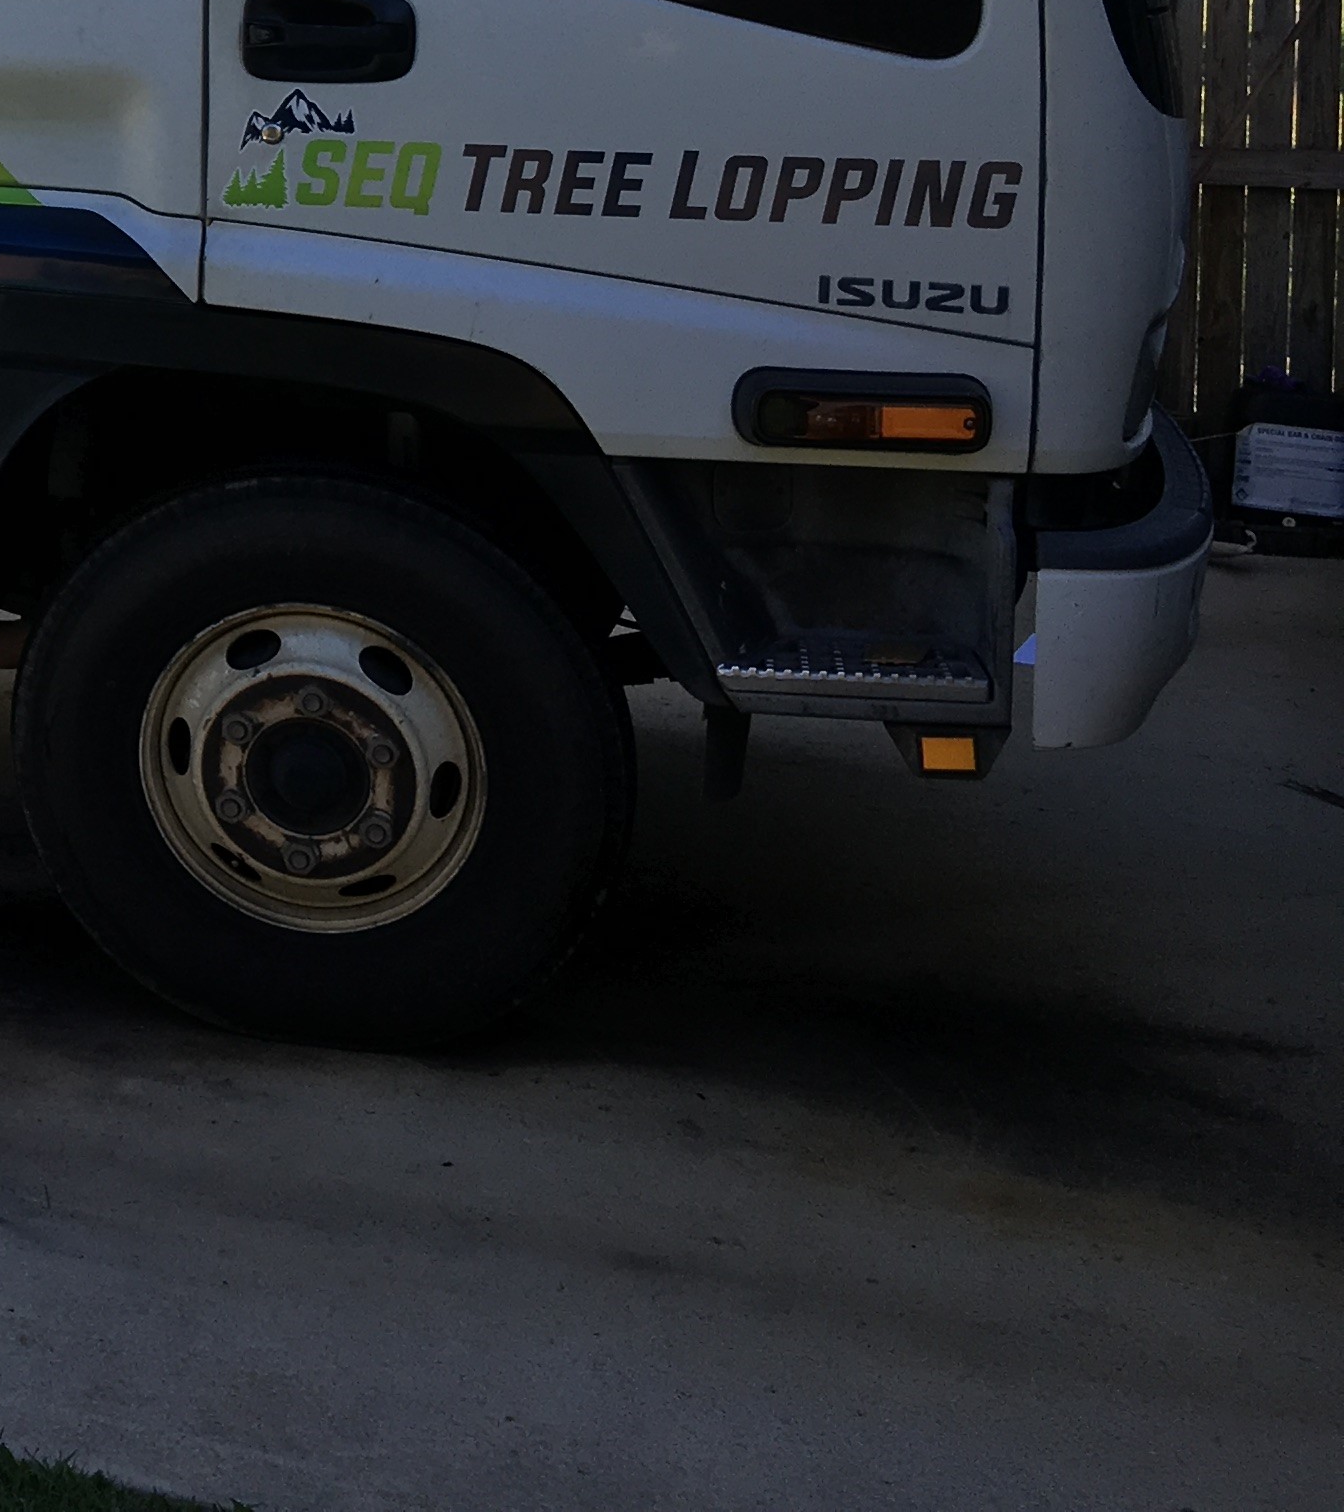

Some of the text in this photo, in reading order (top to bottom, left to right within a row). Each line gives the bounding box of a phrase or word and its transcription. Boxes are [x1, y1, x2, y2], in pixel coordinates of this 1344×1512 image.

[296, 140, 1022, 229] SEQ TREE LOPPING
[817, 275, 1010, 315] ISUZU
